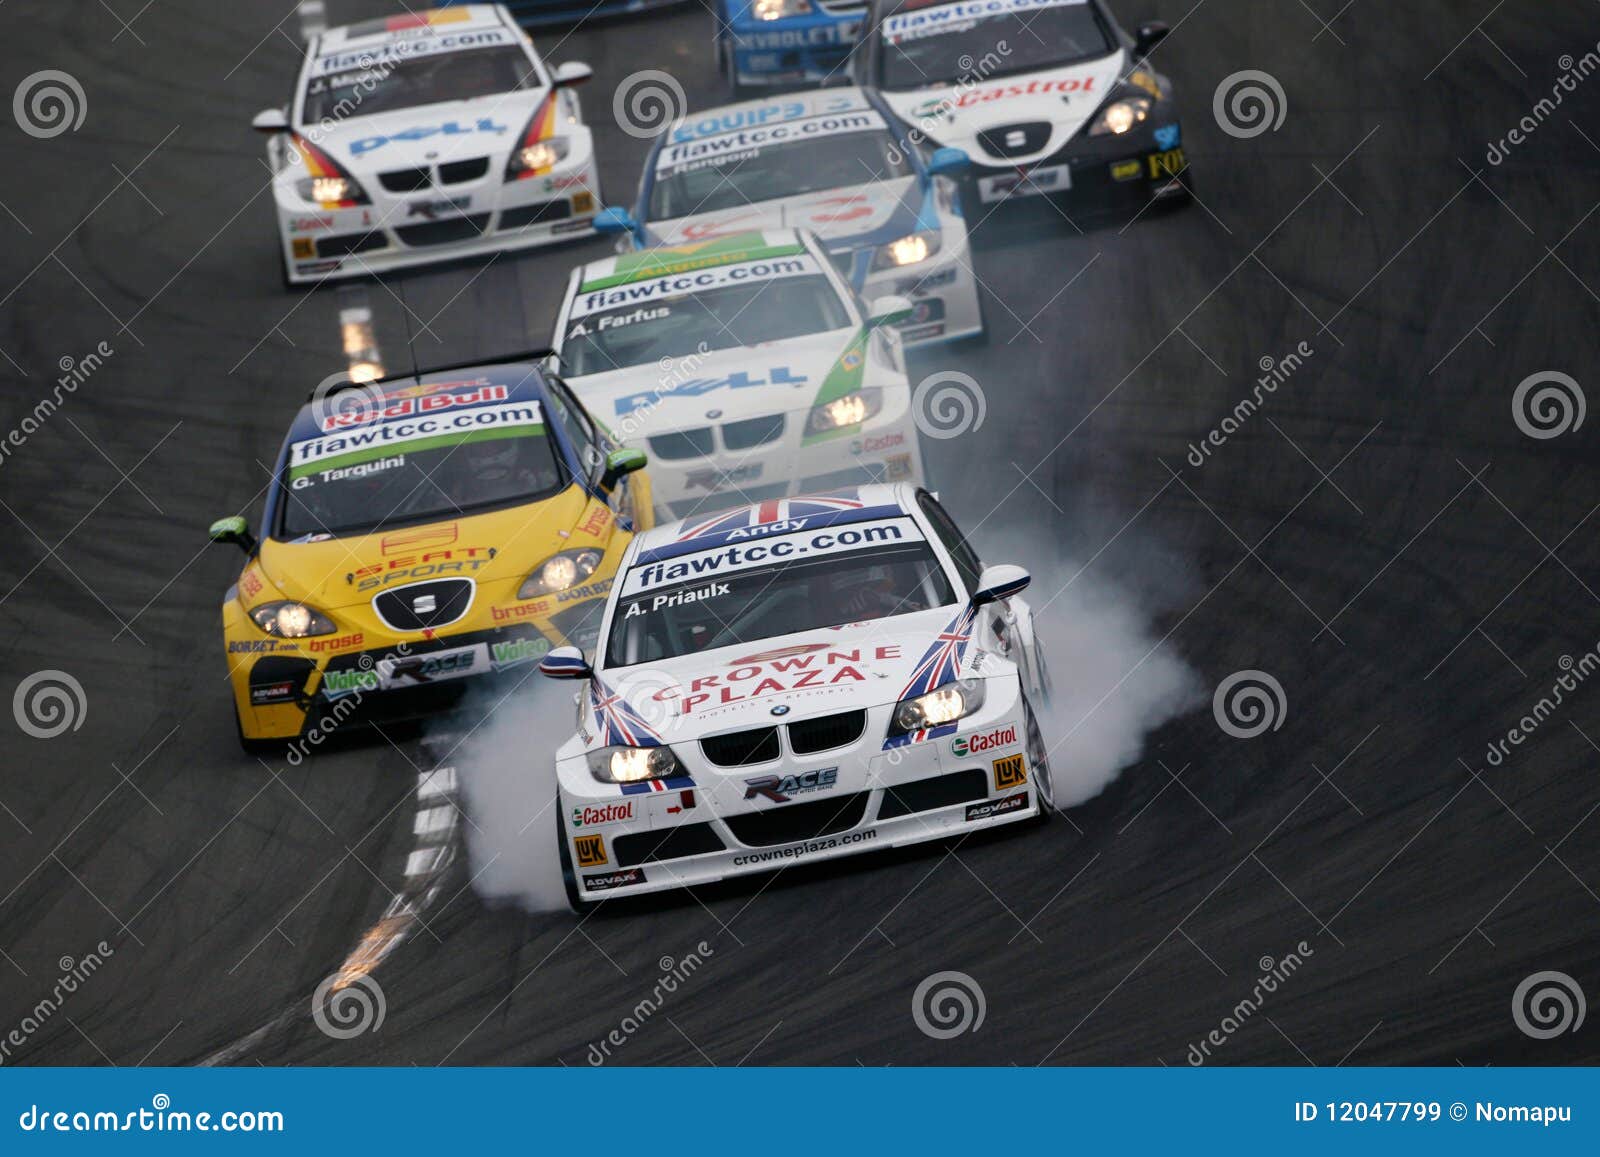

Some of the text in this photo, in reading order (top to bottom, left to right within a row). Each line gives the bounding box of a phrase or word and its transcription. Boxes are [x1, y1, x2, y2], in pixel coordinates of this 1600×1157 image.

[957, 76, 1096, 108] Castrol
[349, 117, 508, 156] DELL
[671, 114, 871, 162] fiawtcc.com
[585, 257, 805, 310] fiawtcc.com
[569, 306, 671, 340] A. Farfus
[324, 385, 508, 431] Red Bull
[613, 366, 809, 416] DELL
[300, 406, 534, 460] fiawtcc.com
[292, 454, 406, 491] G. Tarquini
[725, 517, 809, 542] Andy
[354, 546, 490, 577] SEAT
[639, 524, 903, 588] fiawtcc.com
[357, 558, 491, 593] SPORT
[491, 600, 550, 622] brose
[625, 581, 731, 620] A. Priaulx
[308, 632, 365, 653] brose
[390, 649, 476, 683] RACE
[651, 644, 903, 702] CROWNE
[681, 665, 866, 715] PLAZA
[969, 725, 1017, 753] Castrol
[743, 766, 839, 804] RACE
[583, 801, 633, 825] Castrol
[968, 797, 1023, 816] ADVAN
[586, 873, 637, 887] ADVAN
